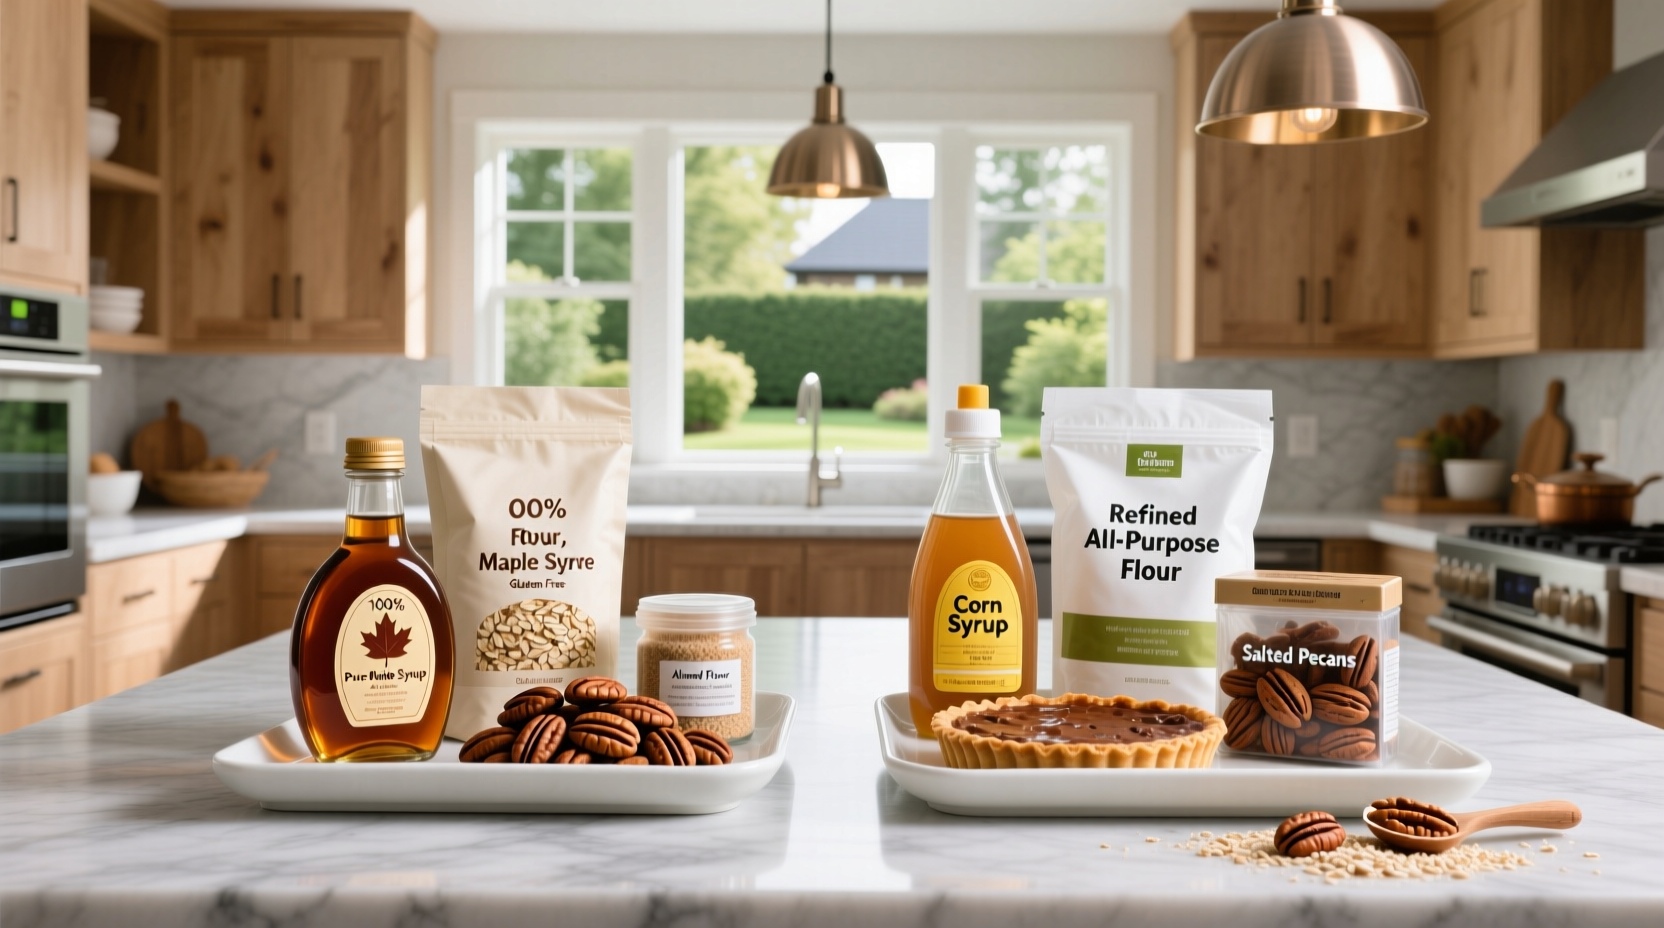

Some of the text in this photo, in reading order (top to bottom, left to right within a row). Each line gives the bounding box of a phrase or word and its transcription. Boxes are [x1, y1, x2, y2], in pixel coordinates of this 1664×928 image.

[1109, 503, 1197, 525] Refined
[1084, 527, 1220, 557] All-Purpose
[479, 552, 539, 574] Maple
[1121, 558, 1182, 581] Flour
[368, 597, 405, 611] 100%
[953, 595, 1002, 614] Corn
[948, 613, 1009, 639] Syrup
[1242, 643, 1357, 668] Salted Pecans
